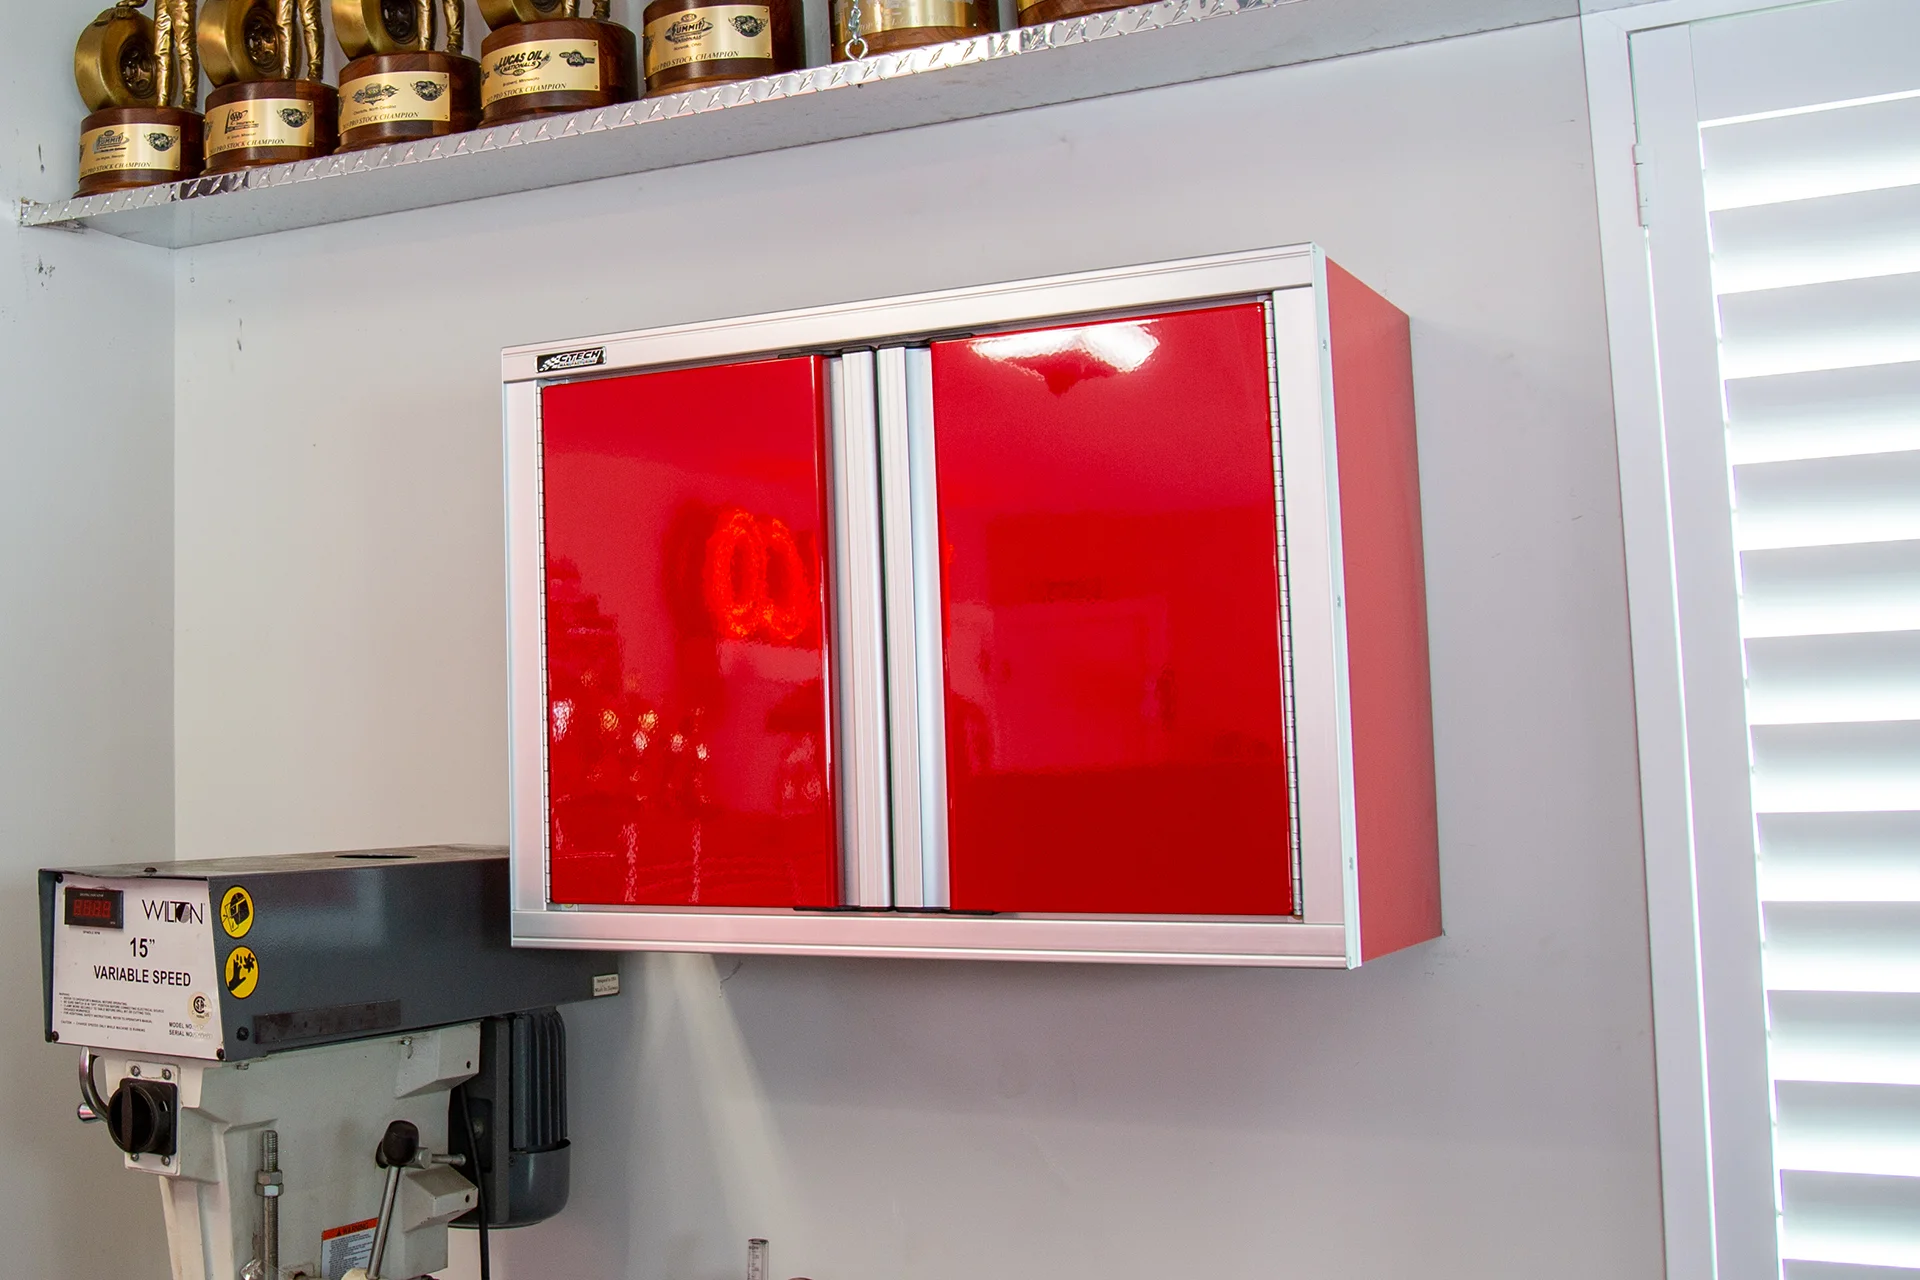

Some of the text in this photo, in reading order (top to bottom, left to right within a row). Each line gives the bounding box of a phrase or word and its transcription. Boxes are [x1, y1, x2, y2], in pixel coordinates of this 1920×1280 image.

[499, 50, 543, 67] LUCAS OIL
[696, 51, 739, 61] CHAMPION
[503, 60, 536, 71] NATIONALS
[525, 83, 566, 93] CHAMPION
[360, 115, 378, 124] STOCK
[378, 111, 420, 121] CHAMPION
[246, 138, 285, 147] CHAMPION
[114, 161, 151, 169] CHAMPION
[142, 899, 205, 925] WILTON
[94, 965, 191, 987] VARIABLE SPEED
